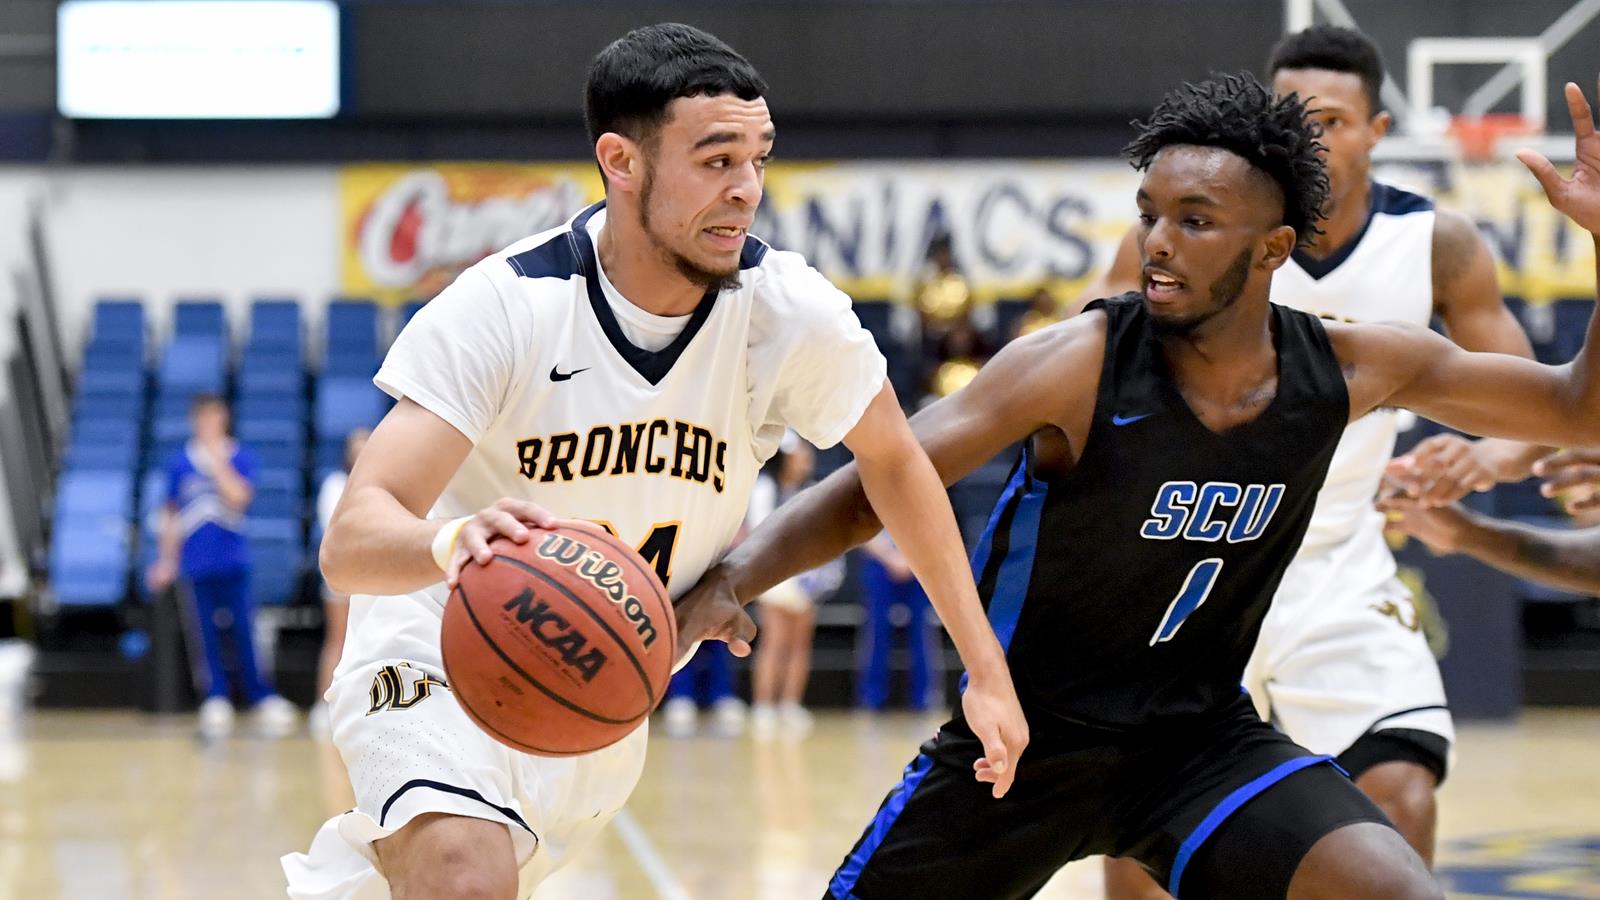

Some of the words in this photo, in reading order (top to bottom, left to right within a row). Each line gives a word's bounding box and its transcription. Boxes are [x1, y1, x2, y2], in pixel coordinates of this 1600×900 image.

[752, 177, 1095, 279] ANIACS
[590, 519, 682, 592] 4
[1140, 481, 1286, 543] SCU
[503, 586, 609, 683] NCAA
[536, 532, 657, 654] Wilson
[1149, 557, 1224, 647] 1
